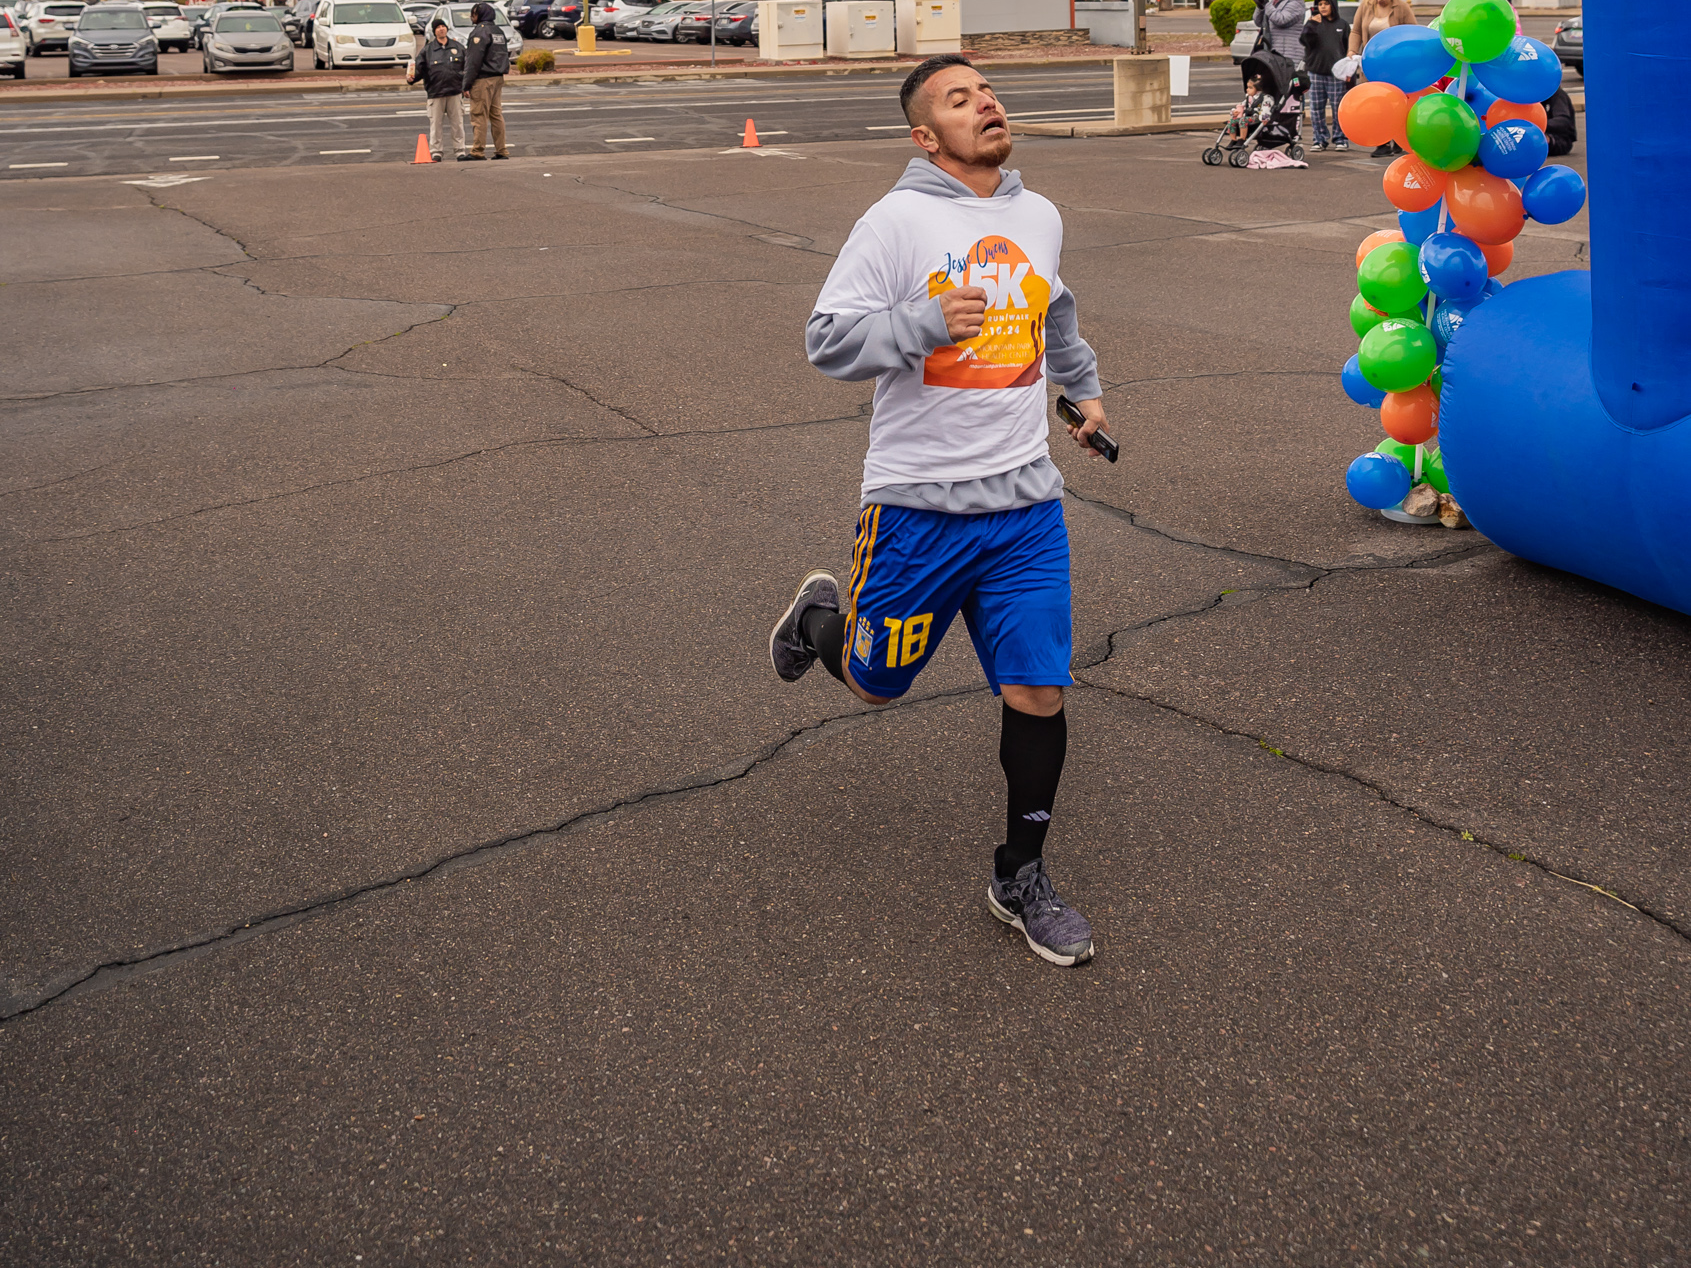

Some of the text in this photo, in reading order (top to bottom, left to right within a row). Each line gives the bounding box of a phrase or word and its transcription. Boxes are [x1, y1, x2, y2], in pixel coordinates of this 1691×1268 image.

[935, 240, 1008, 284] Jesse Owens
[968, 262, 1031, 311] 5K
[987, 313, 1029, 322] RUN/WALK
[884, 613, 934, 668] 18
